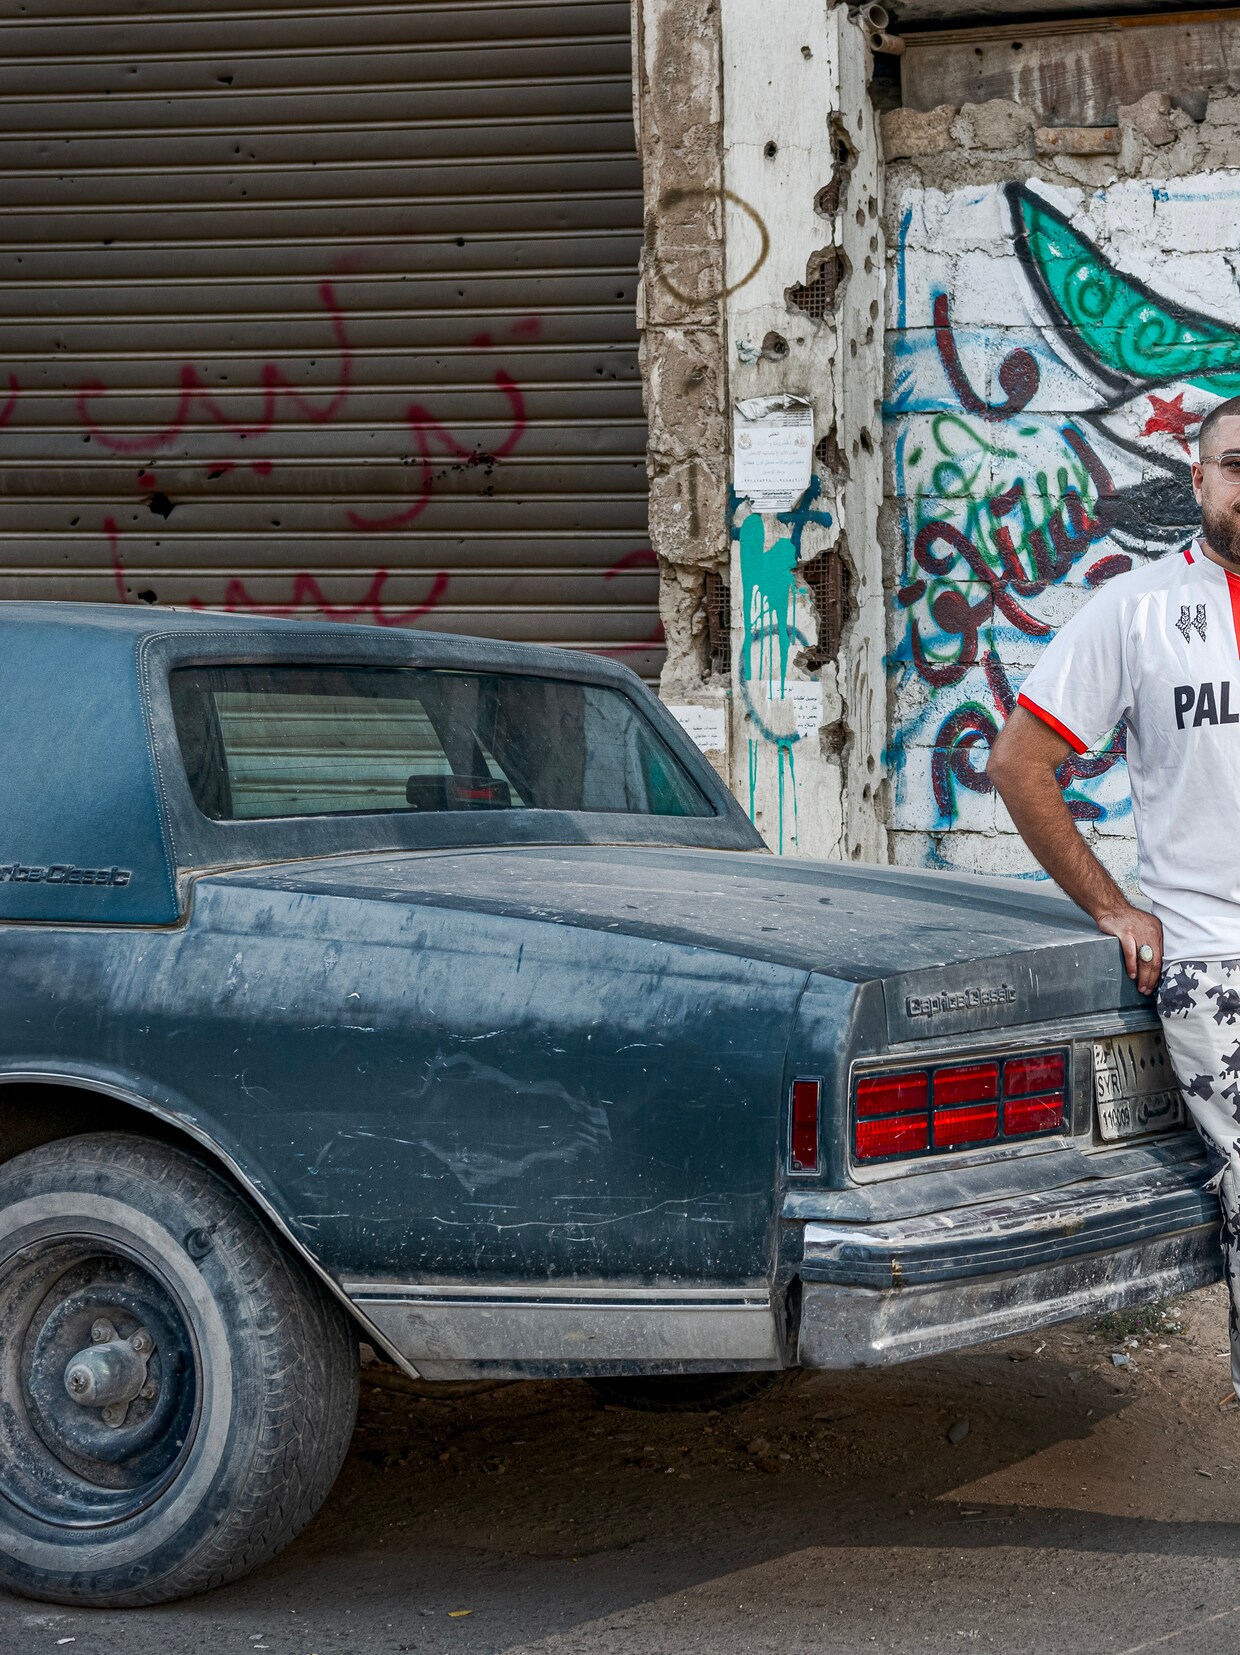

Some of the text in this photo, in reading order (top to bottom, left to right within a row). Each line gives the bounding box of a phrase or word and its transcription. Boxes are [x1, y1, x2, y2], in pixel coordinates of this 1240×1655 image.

[45, 863, 132, 887] Classic
[904, 982, 1017, 1018] Caprice Classic
[1097, 1073, 1120, 1098] SYR
